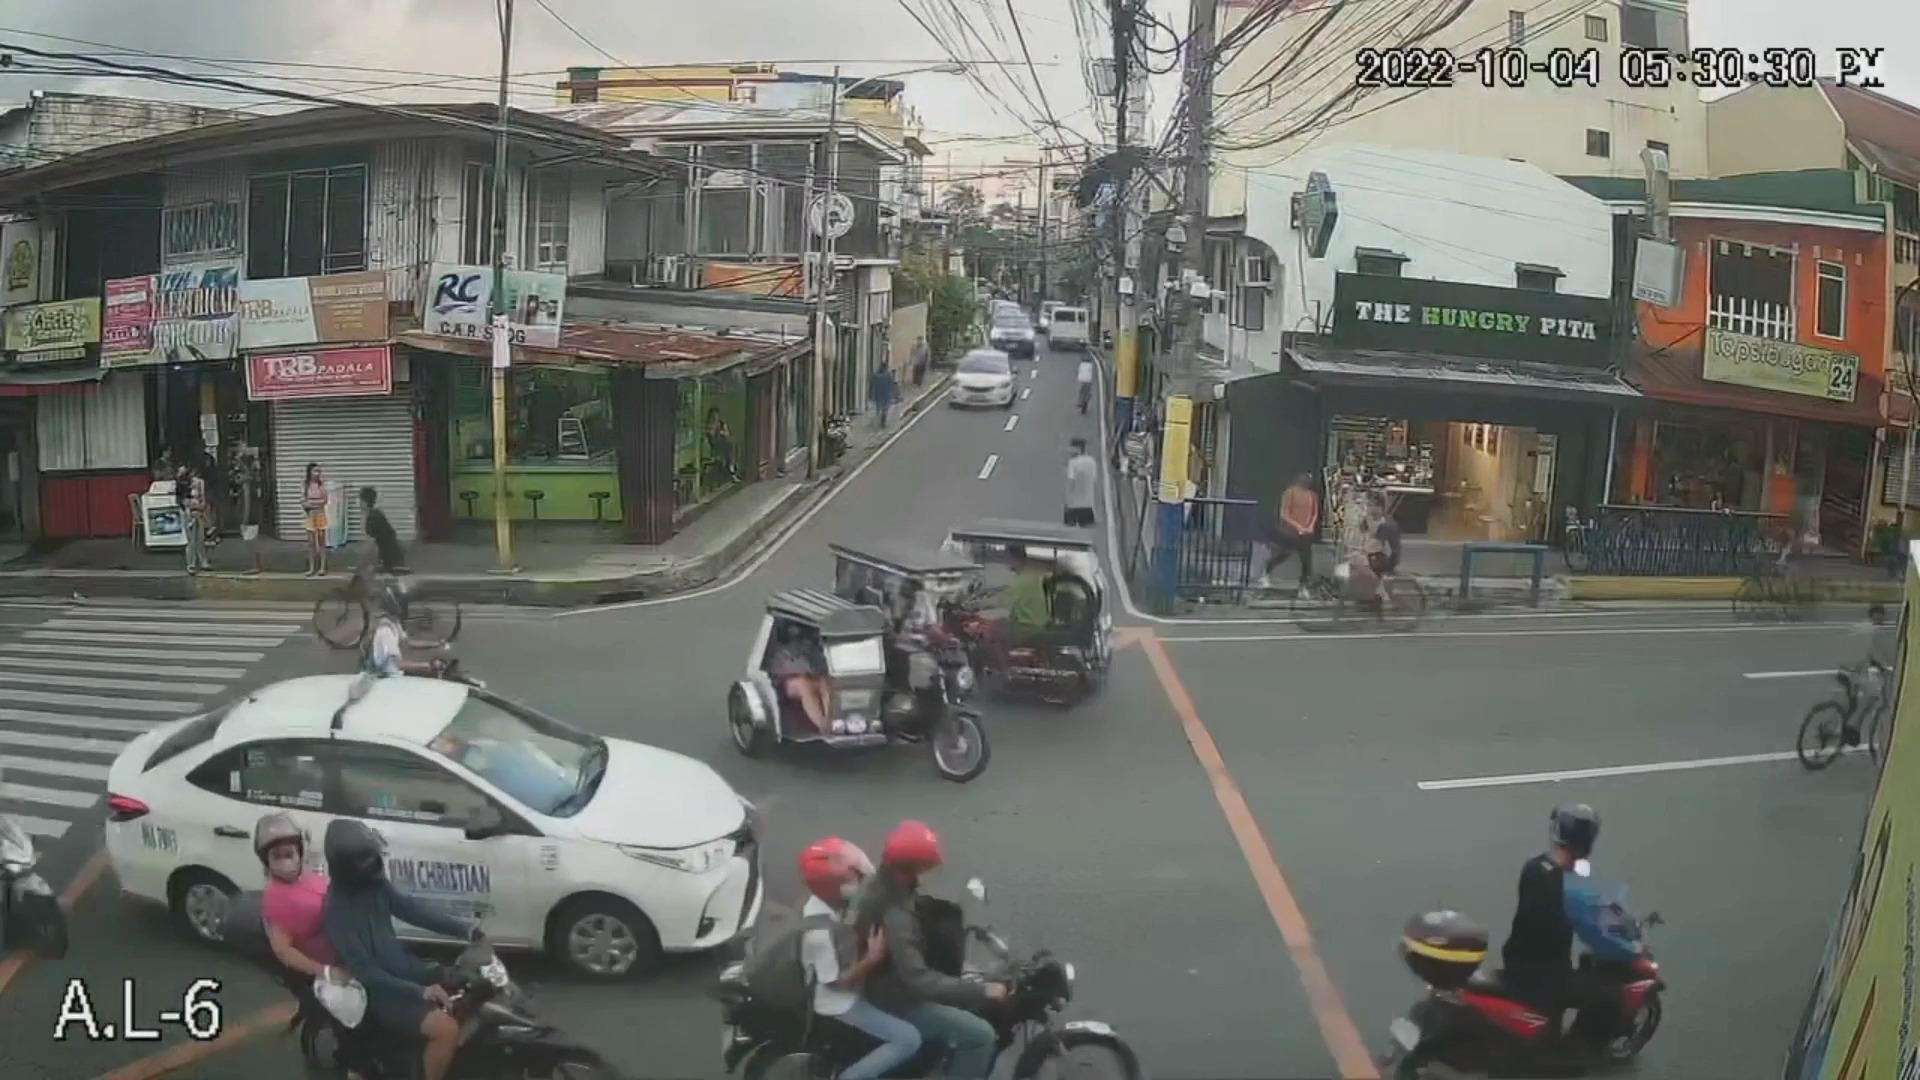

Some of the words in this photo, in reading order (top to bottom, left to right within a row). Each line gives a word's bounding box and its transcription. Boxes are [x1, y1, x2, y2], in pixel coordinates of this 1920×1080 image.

[432, 273, 481, 309] RC
[1355, 301, 1411, 324] THE
[1421, 306, 1531, 333] HUNGRY
[1540, 317, 1597, 340] PITA
[263, 355, 316, 380] TRB
[317, 361, 373, 375] PADALA
[1831, 366, 1852, 390] 24
[416, 860, 490, 893] CHRISTIAN
